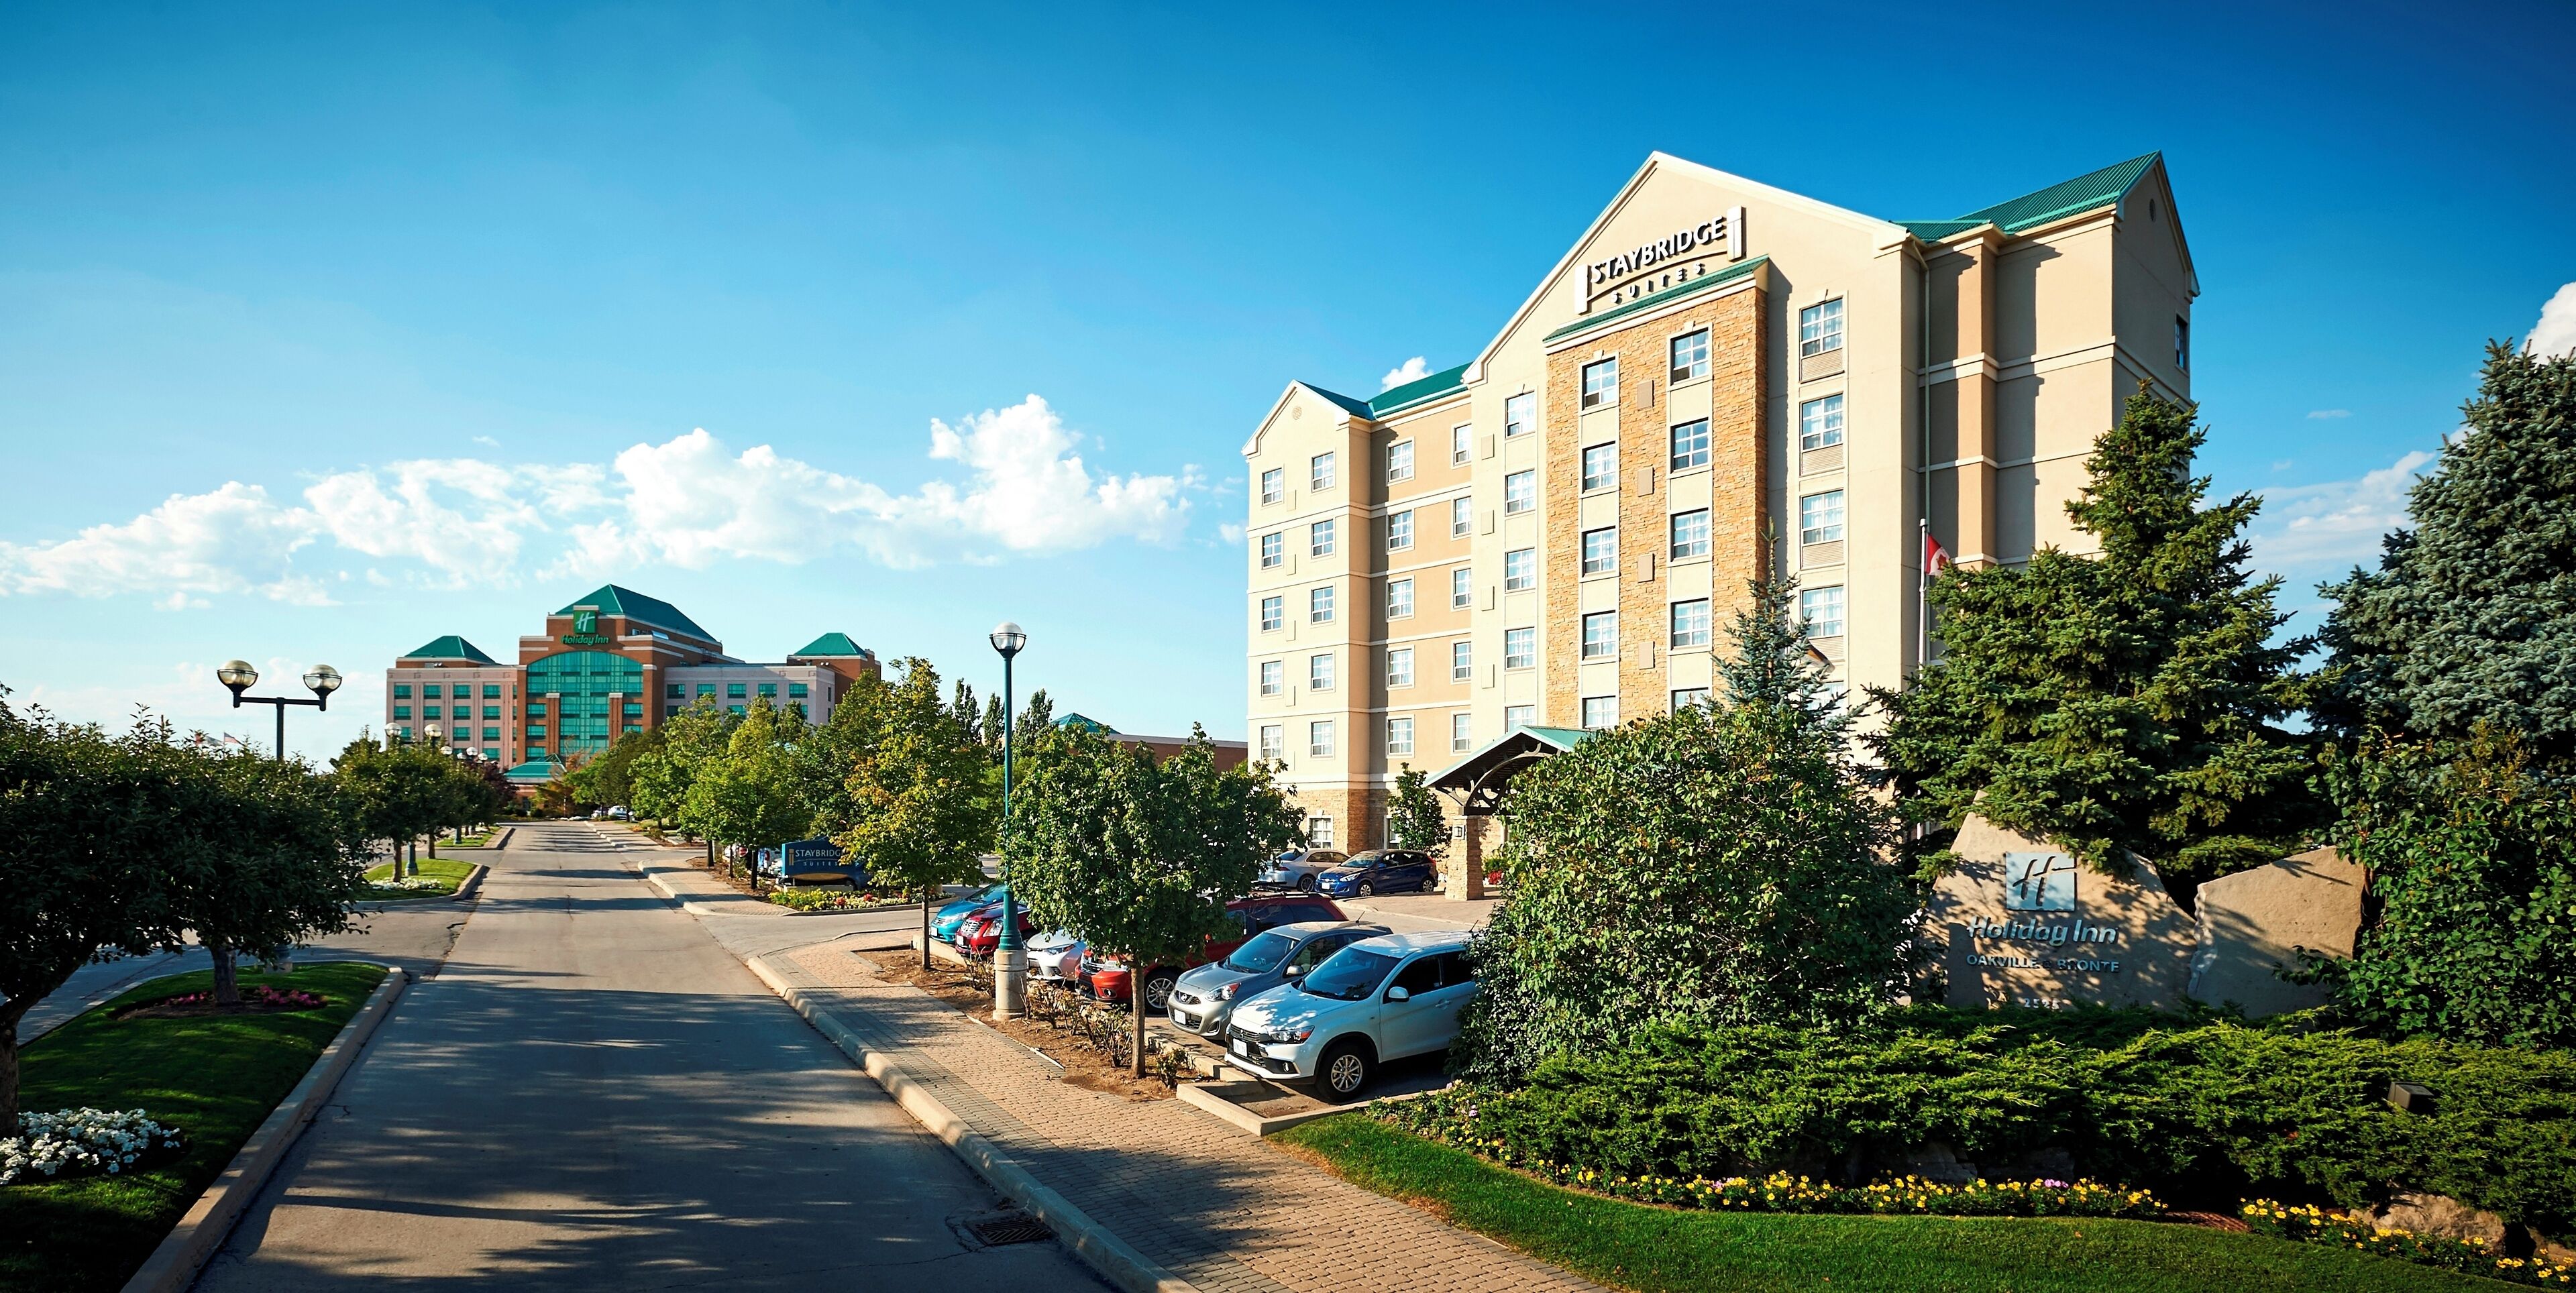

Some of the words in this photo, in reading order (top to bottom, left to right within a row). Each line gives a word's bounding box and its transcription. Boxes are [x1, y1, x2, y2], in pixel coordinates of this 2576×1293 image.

[1591, 215, 1725, 284] STAYBRIDGE
[1611, 263, 1707, 304] SUITES
[561, 634, 594, 645] Holiday
[595, 634, 608, 643] Inn
[1966, 917, 2068, 946] Holiday
[2073, 919, 2116, 943] Inn
[1966, 954, 2038, 968] OAKVILLE
